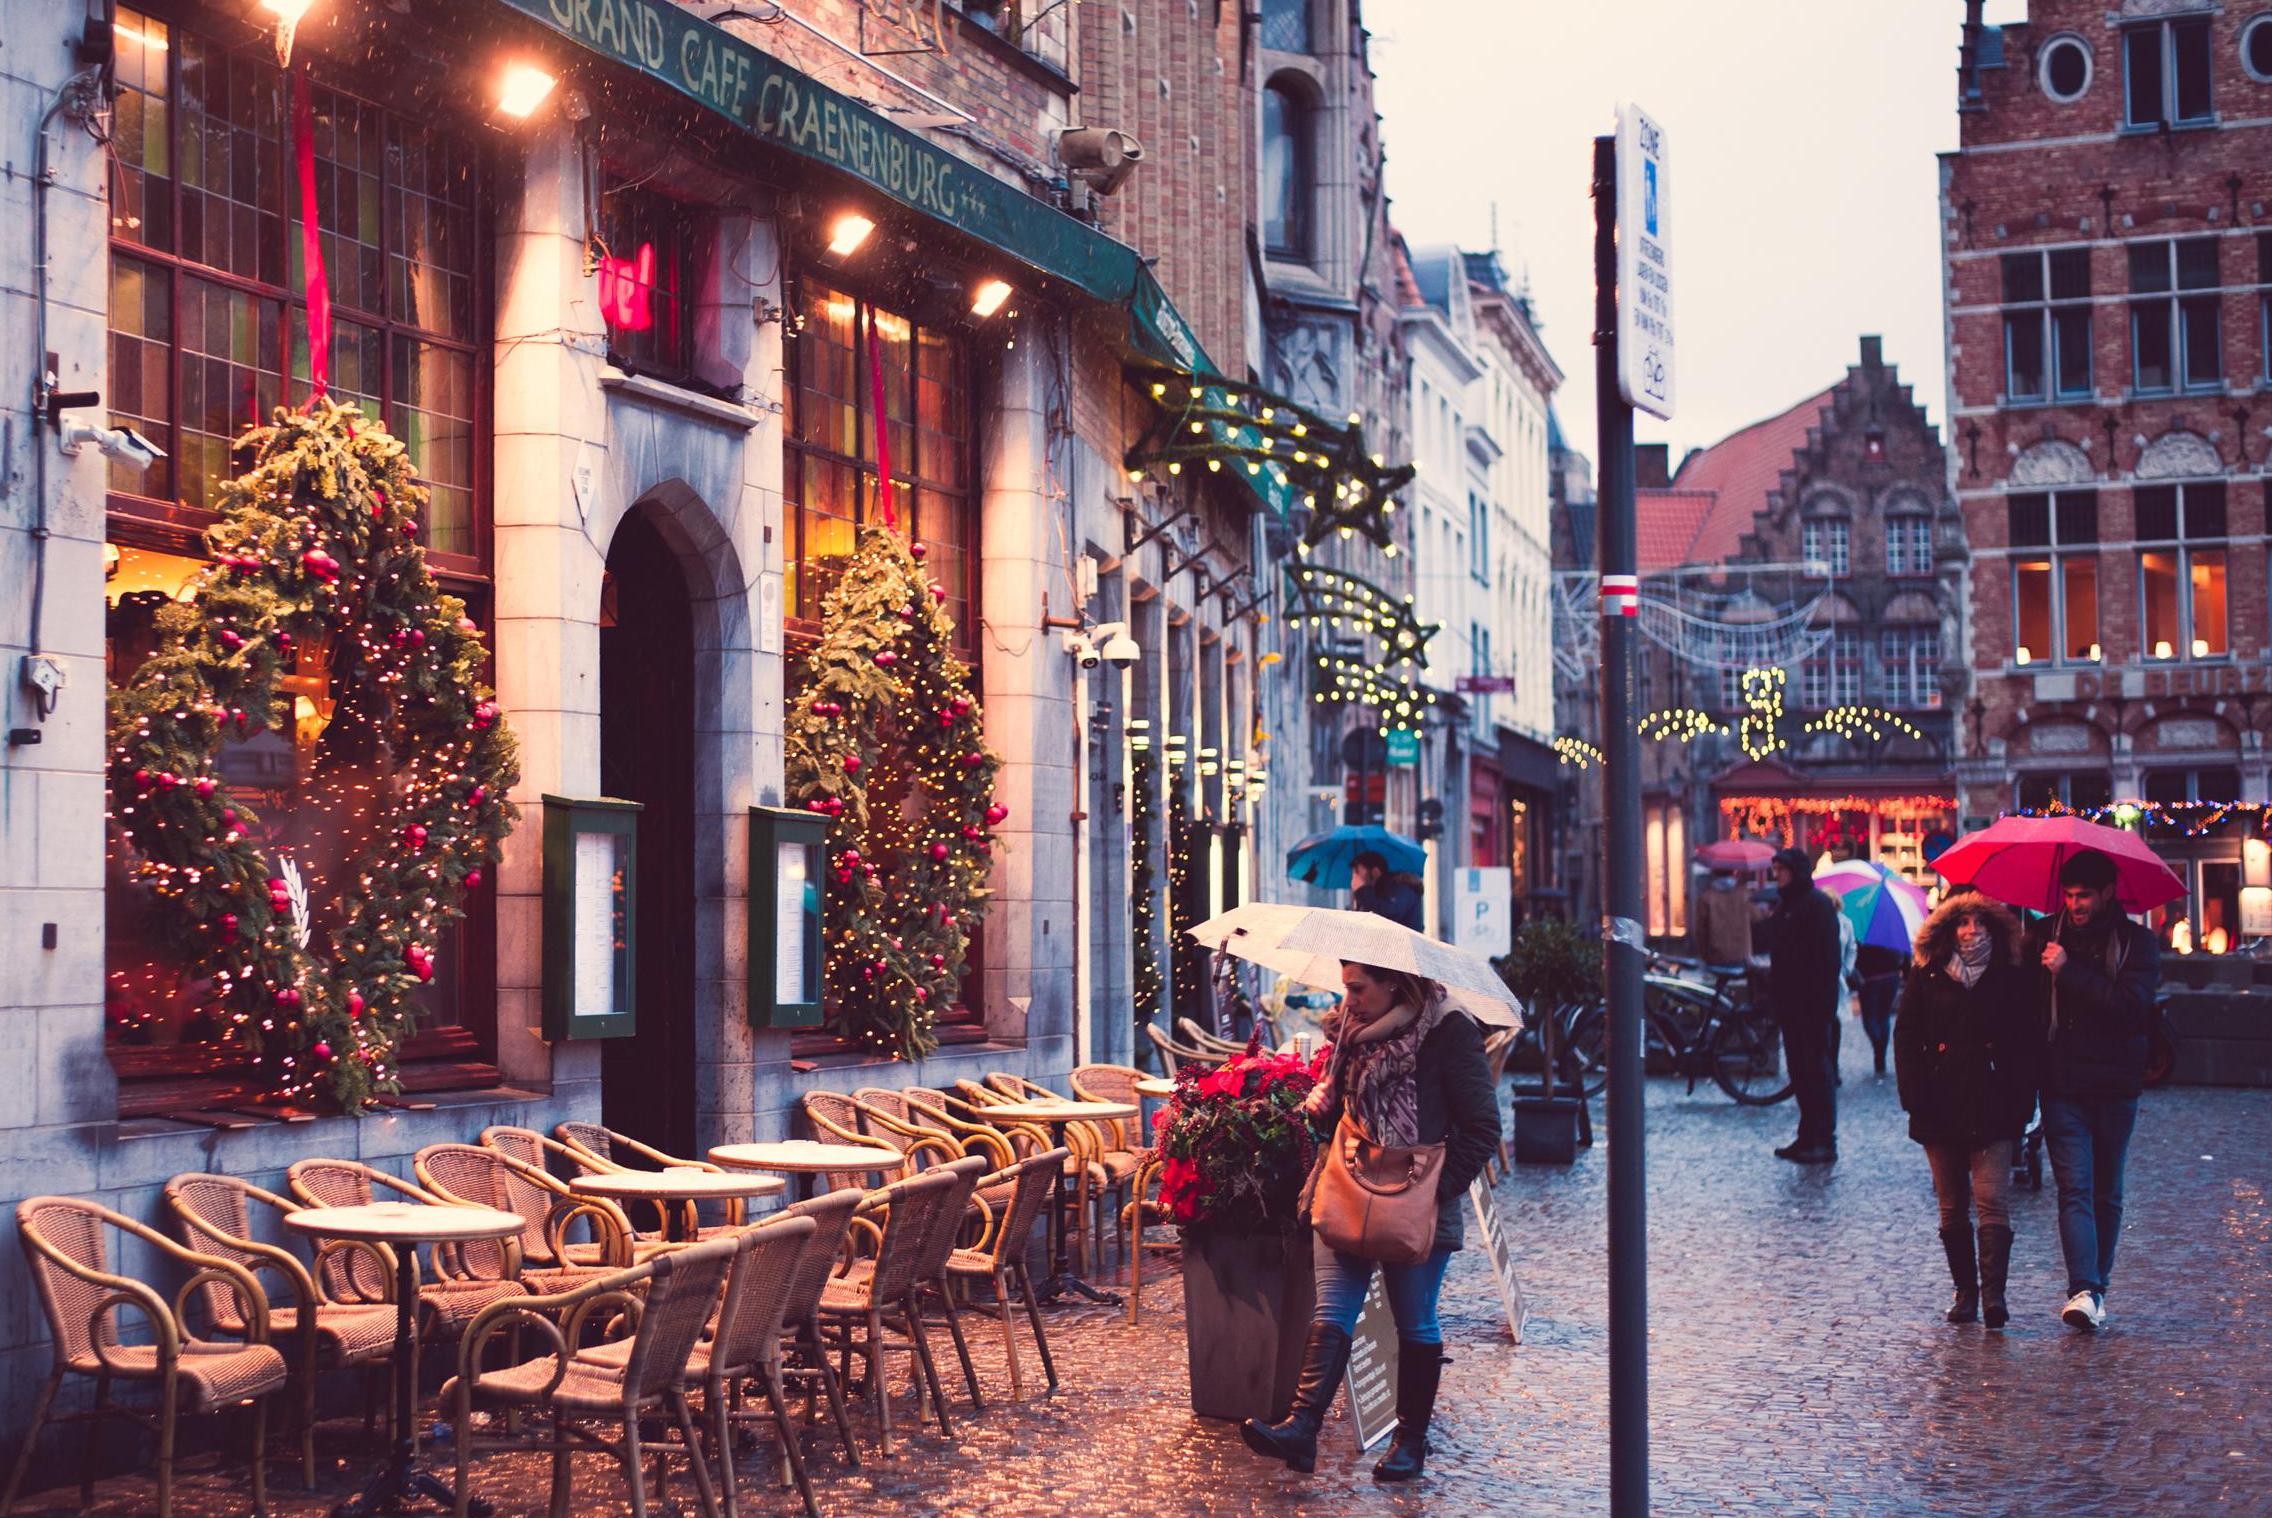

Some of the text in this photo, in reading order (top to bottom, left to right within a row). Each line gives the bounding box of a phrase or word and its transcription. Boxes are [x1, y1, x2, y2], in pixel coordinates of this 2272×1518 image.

[681, 29, 750, 116] CAFE
[757, 74, 955, 217] CRAENENBURG
[1475, 901, 1489, 920] P
